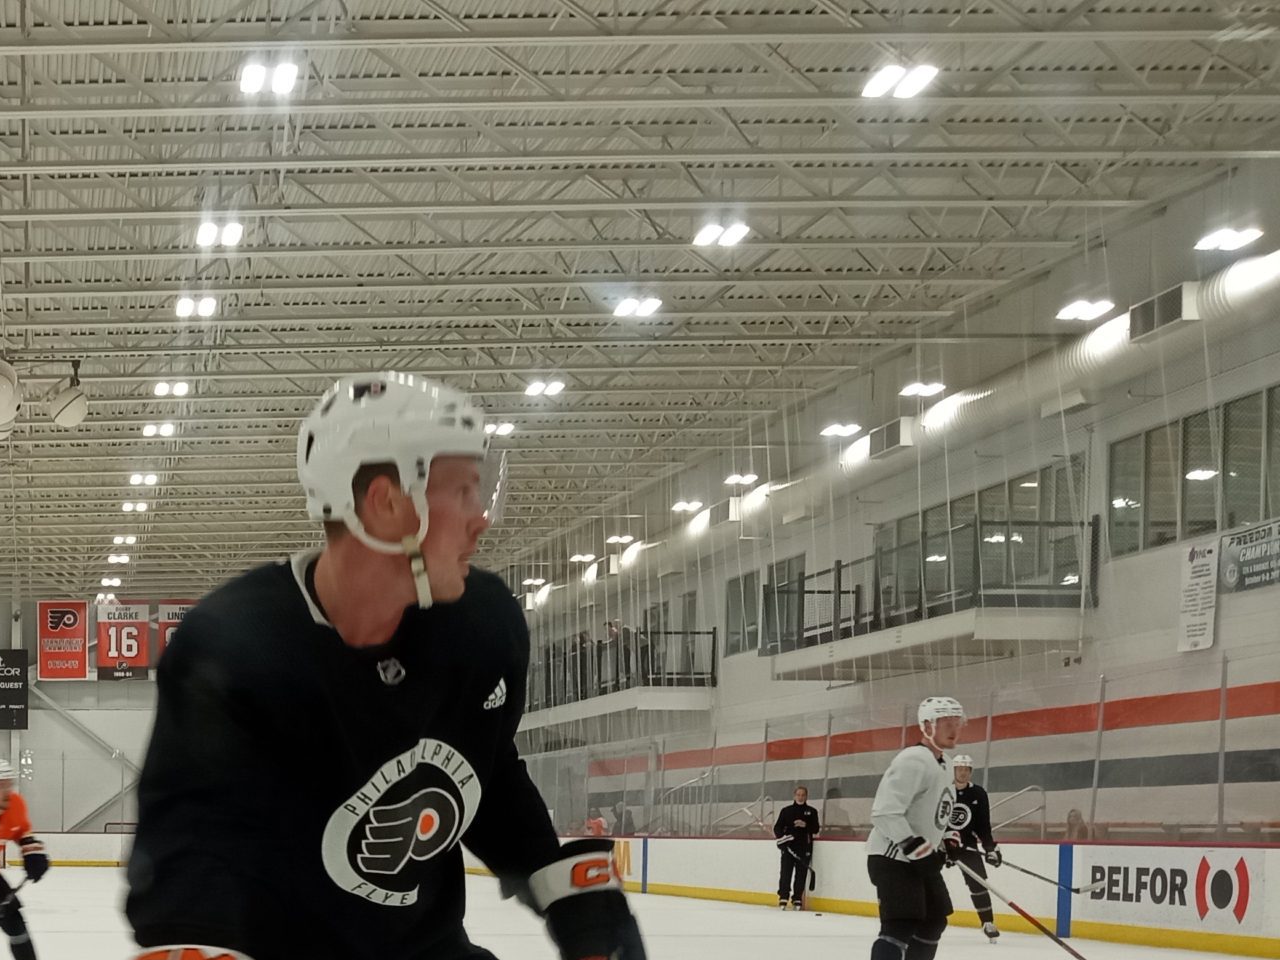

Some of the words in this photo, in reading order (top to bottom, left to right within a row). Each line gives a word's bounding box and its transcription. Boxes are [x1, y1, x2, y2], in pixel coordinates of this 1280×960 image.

[107, 611, 139, 620] CLARKE
[108, 626, 138, 658] 16
[343, 740, 474, 817] PHILALPHIA
[351, 881, 410, 905] FLYE
[1090, 865, 1188, 906] BELFOR
